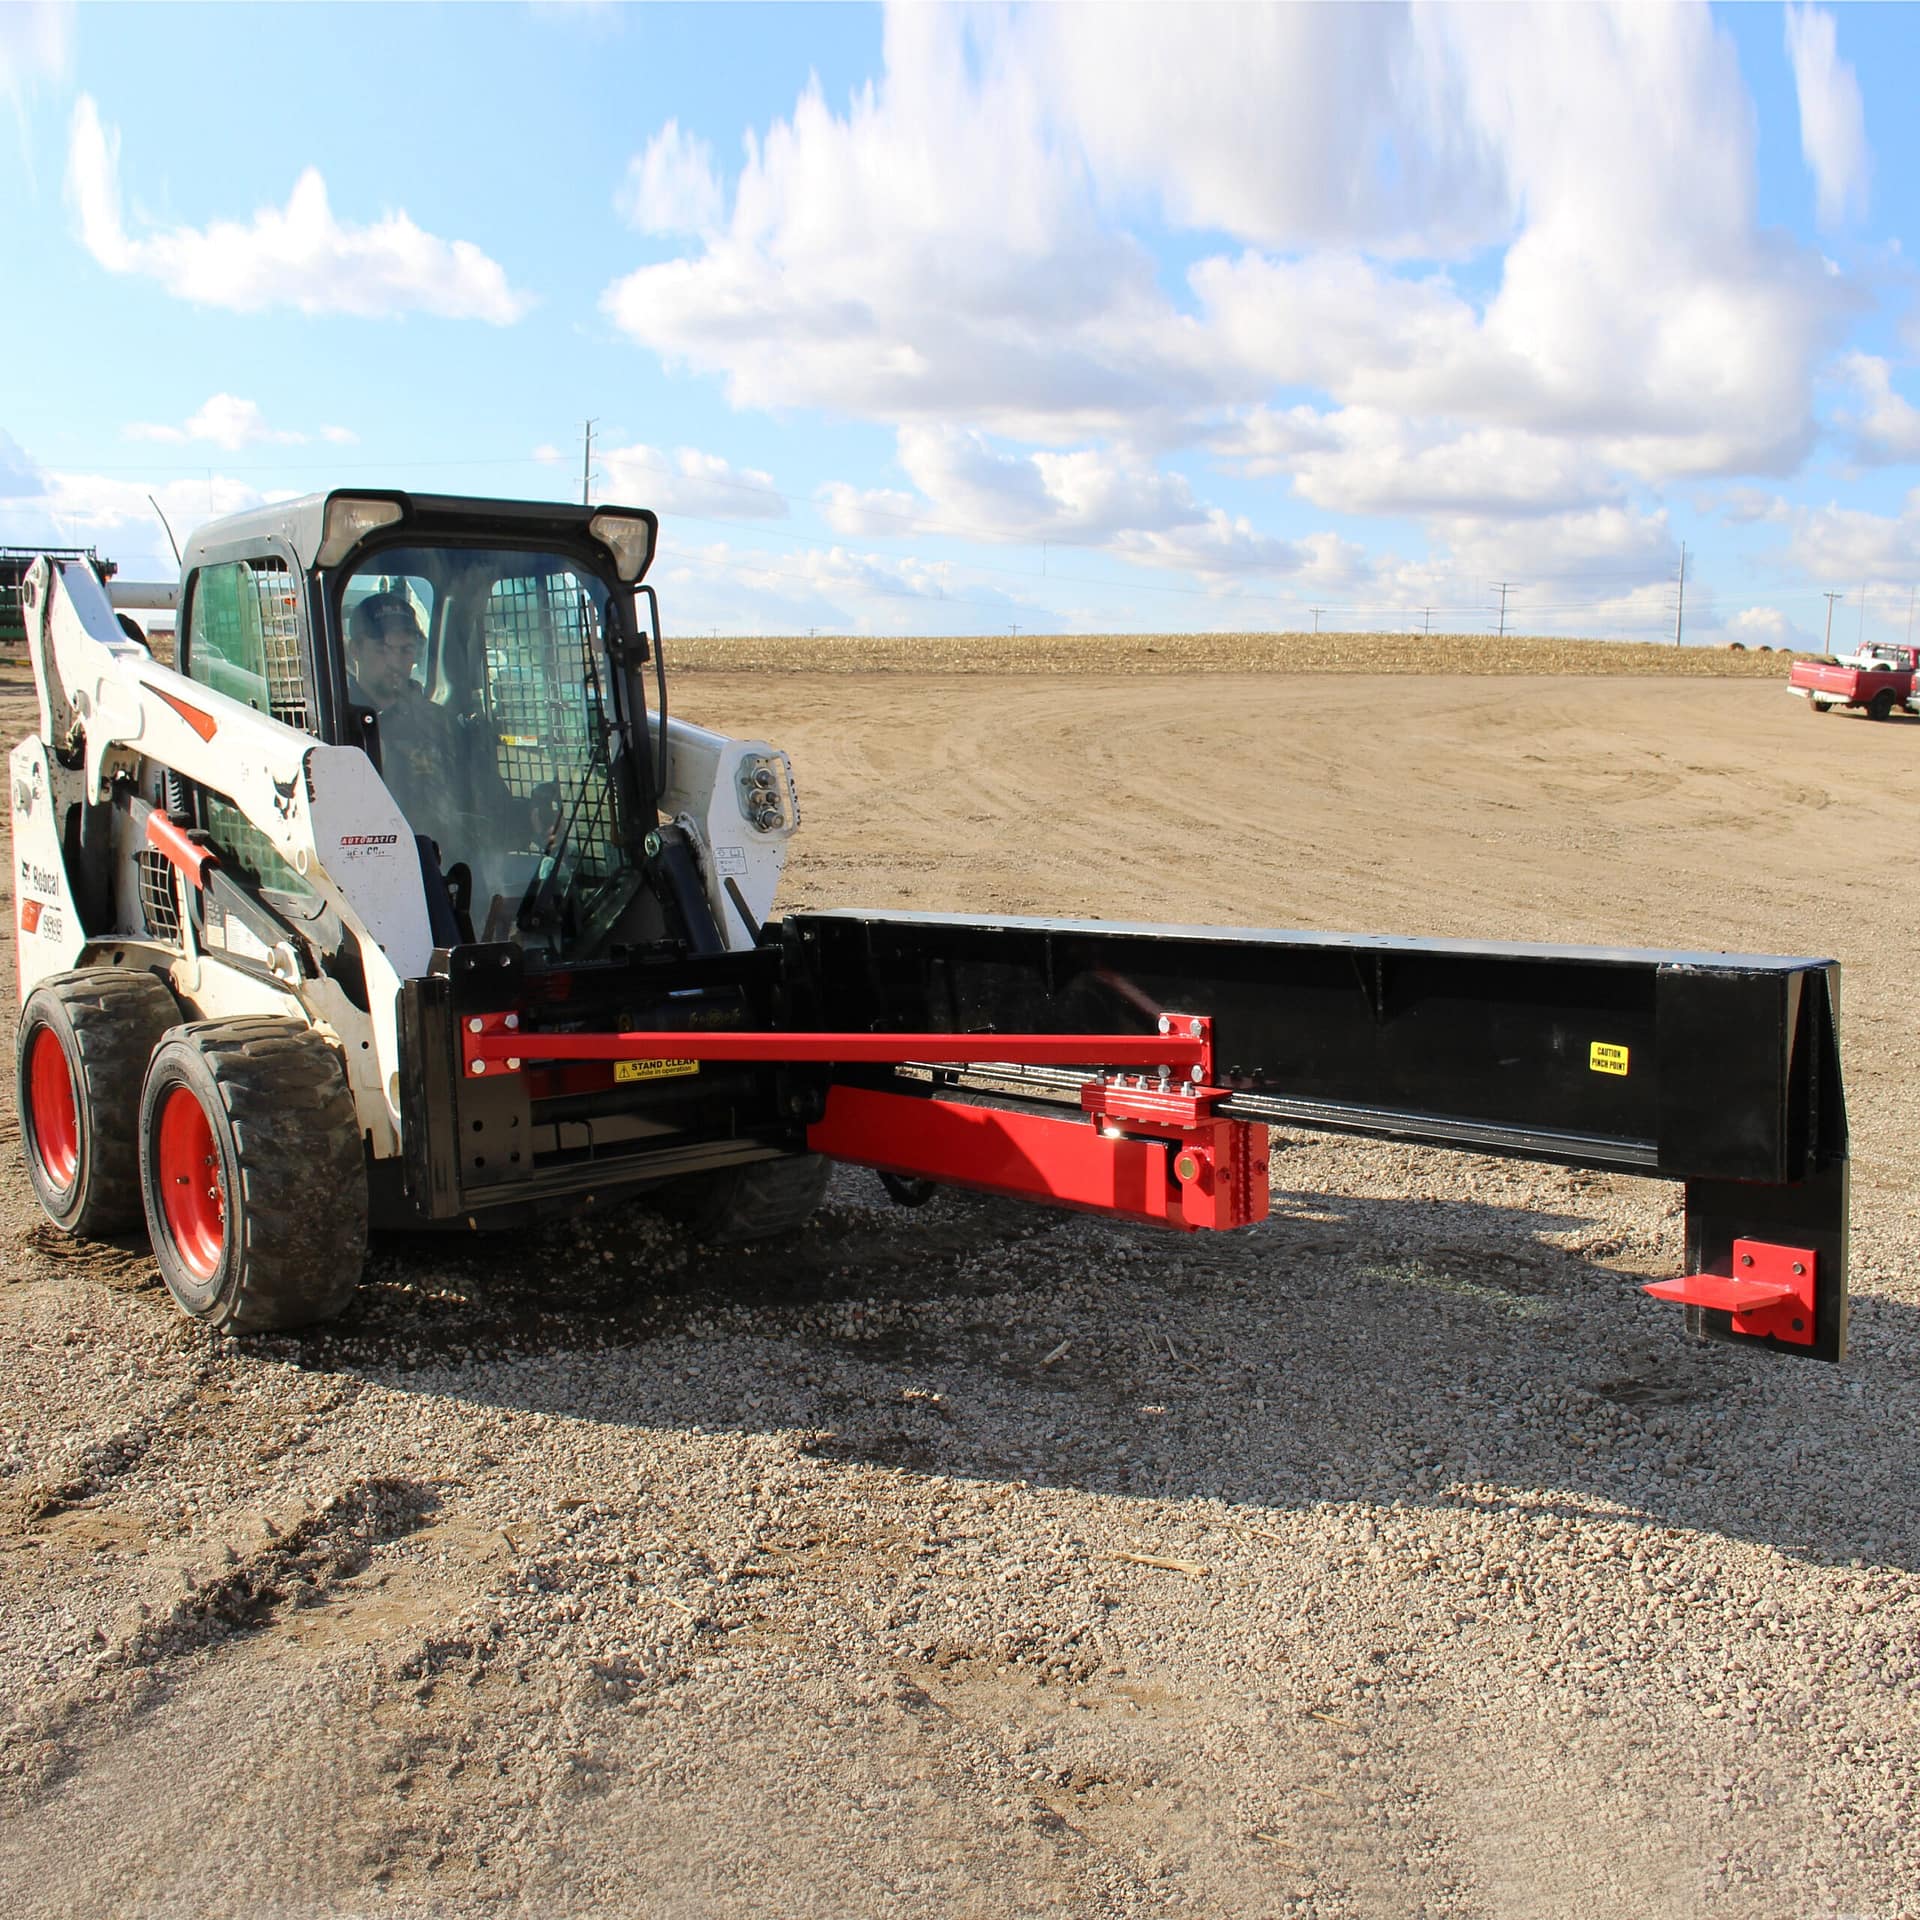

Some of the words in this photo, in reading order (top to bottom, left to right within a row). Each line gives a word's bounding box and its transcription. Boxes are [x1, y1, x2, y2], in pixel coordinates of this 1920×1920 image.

[342, 835, 397, 845] AUTOMATIC
[33, 865, 59, 896] Bobcat
[1597, 1046, 1621, 1059] CAUTION
[631, 1060, 663, 1071] STAND
[1592, 1057, 1609, 1068] PINCH
[1609, 1060, 1626, 1071] POINT
[637, 1069, 654, 1077] while
[662, 1065, 692, 1074] operation
